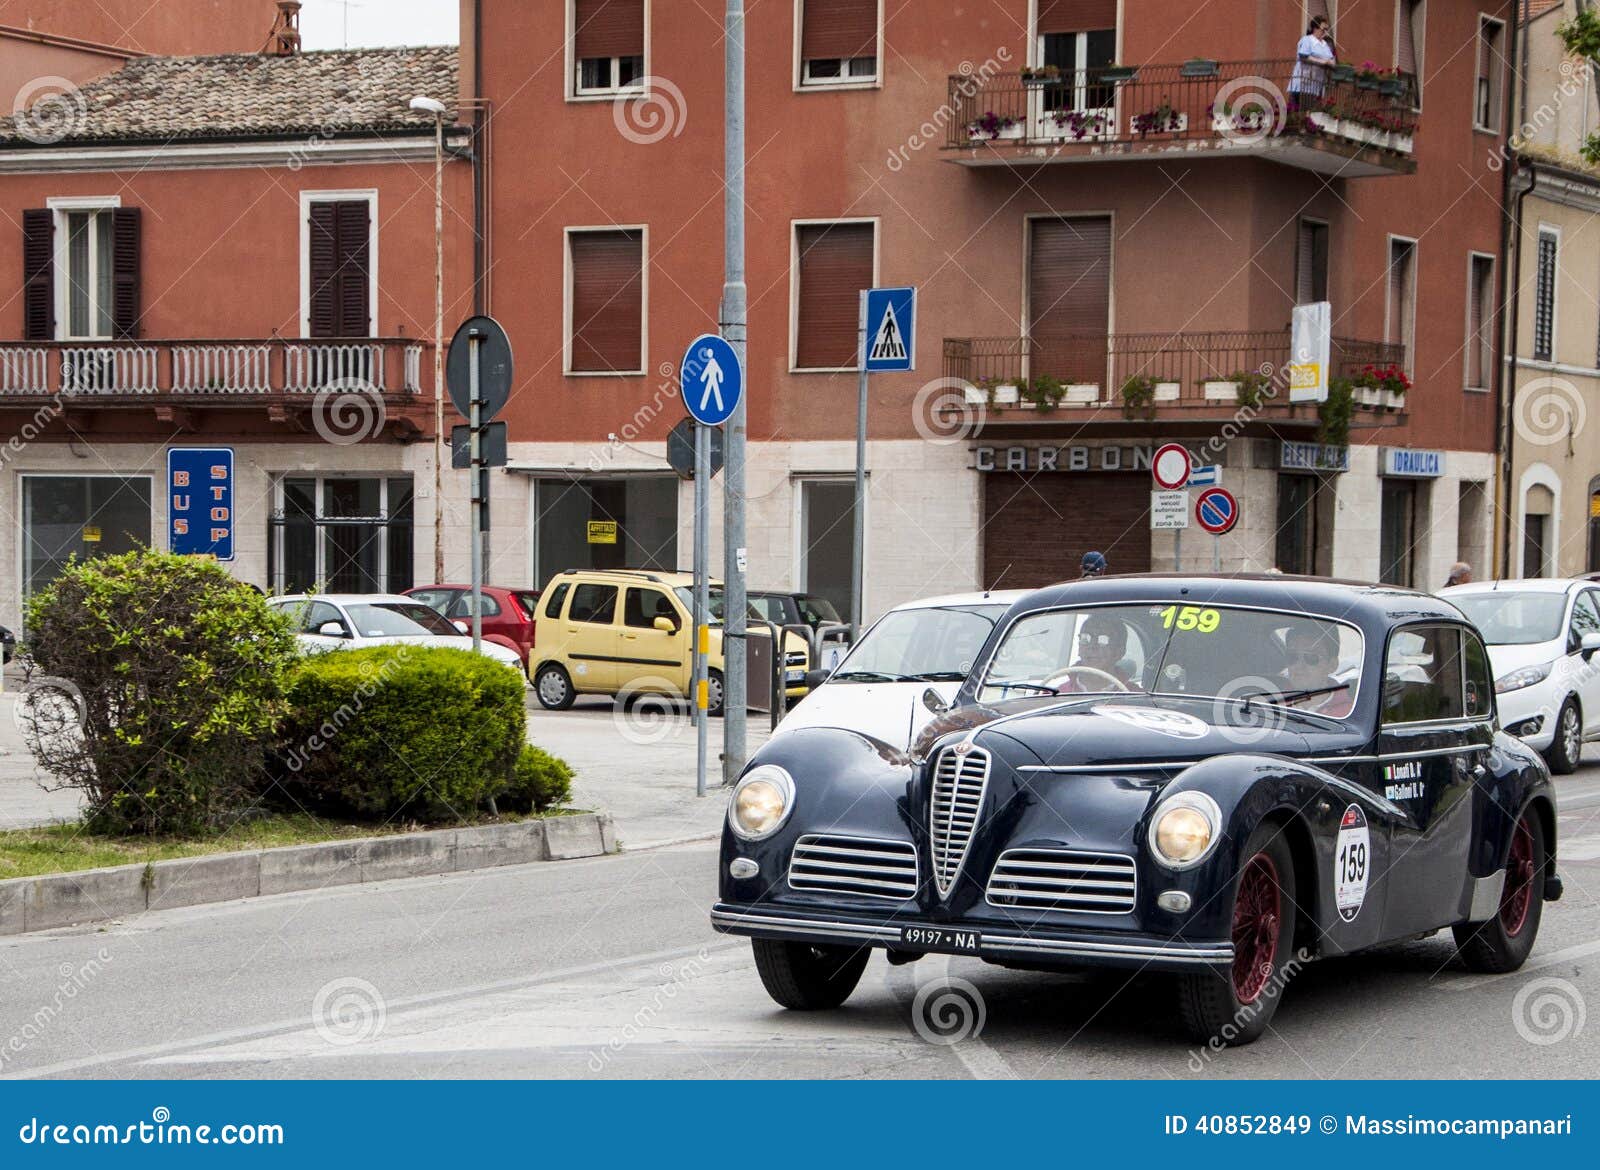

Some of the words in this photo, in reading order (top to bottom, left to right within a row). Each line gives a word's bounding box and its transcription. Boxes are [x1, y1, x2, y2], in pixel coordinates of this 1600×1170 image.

[1394, 451, 1439, 473] IDRAULICA
[173, 470, 190, 535] BUS
[209, 465, 229, 542] STOP
[1160, 605, 1220, 632] 159
[1340, 842, 1366, 884] 159
[906, 928, 942, 944] 49197
[955, 933, 976, 949] NA
